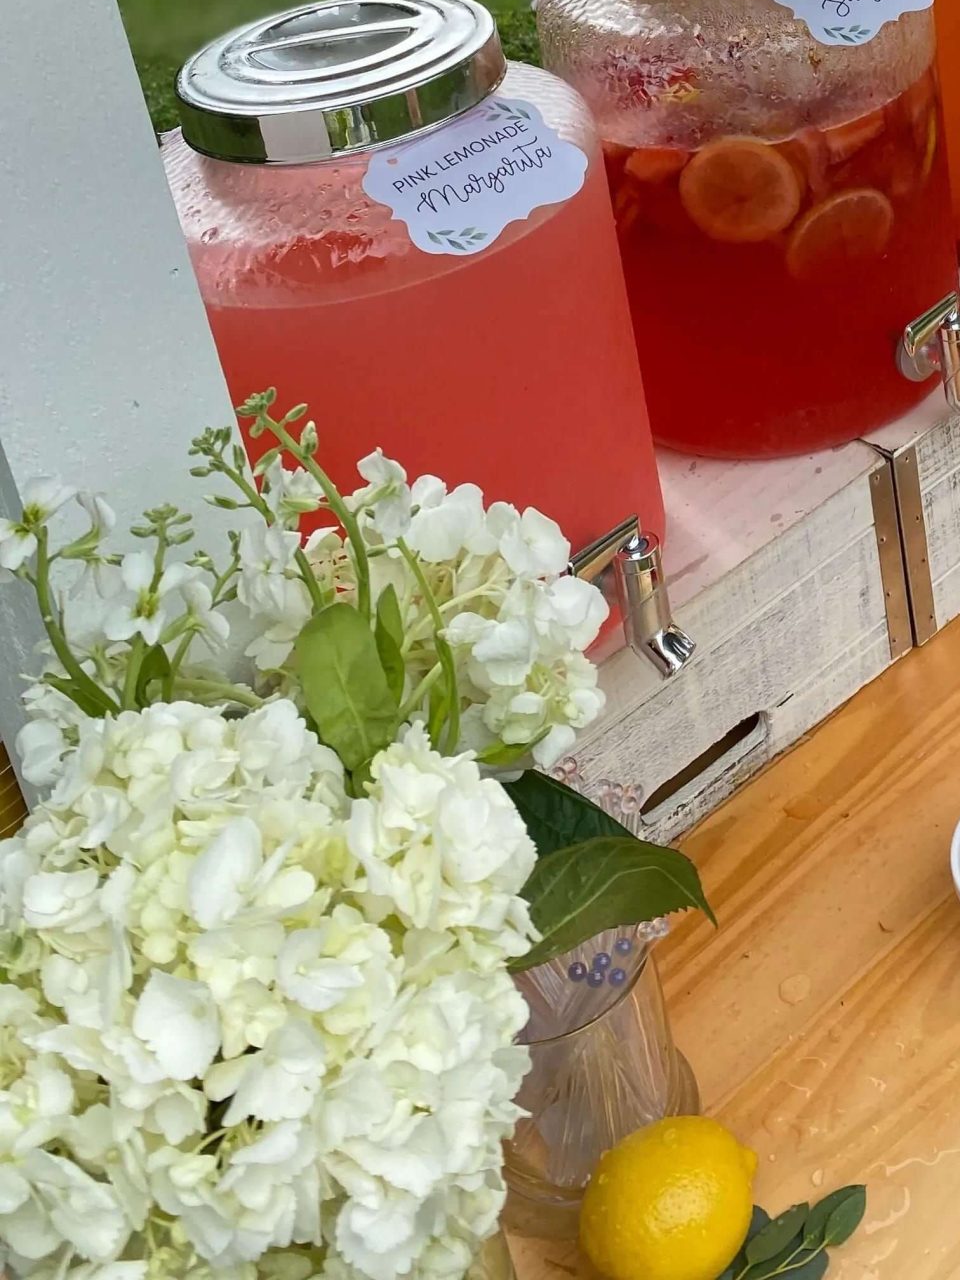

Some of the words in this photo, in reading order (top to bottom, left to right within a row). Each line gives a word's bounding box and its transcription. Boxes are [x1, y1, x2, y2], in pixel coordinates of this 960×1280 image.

[392, 165, 438, 194] PINK
[434, 120, 529, 172] LEMONADE
[416, 136, 553, 214] Margarita
